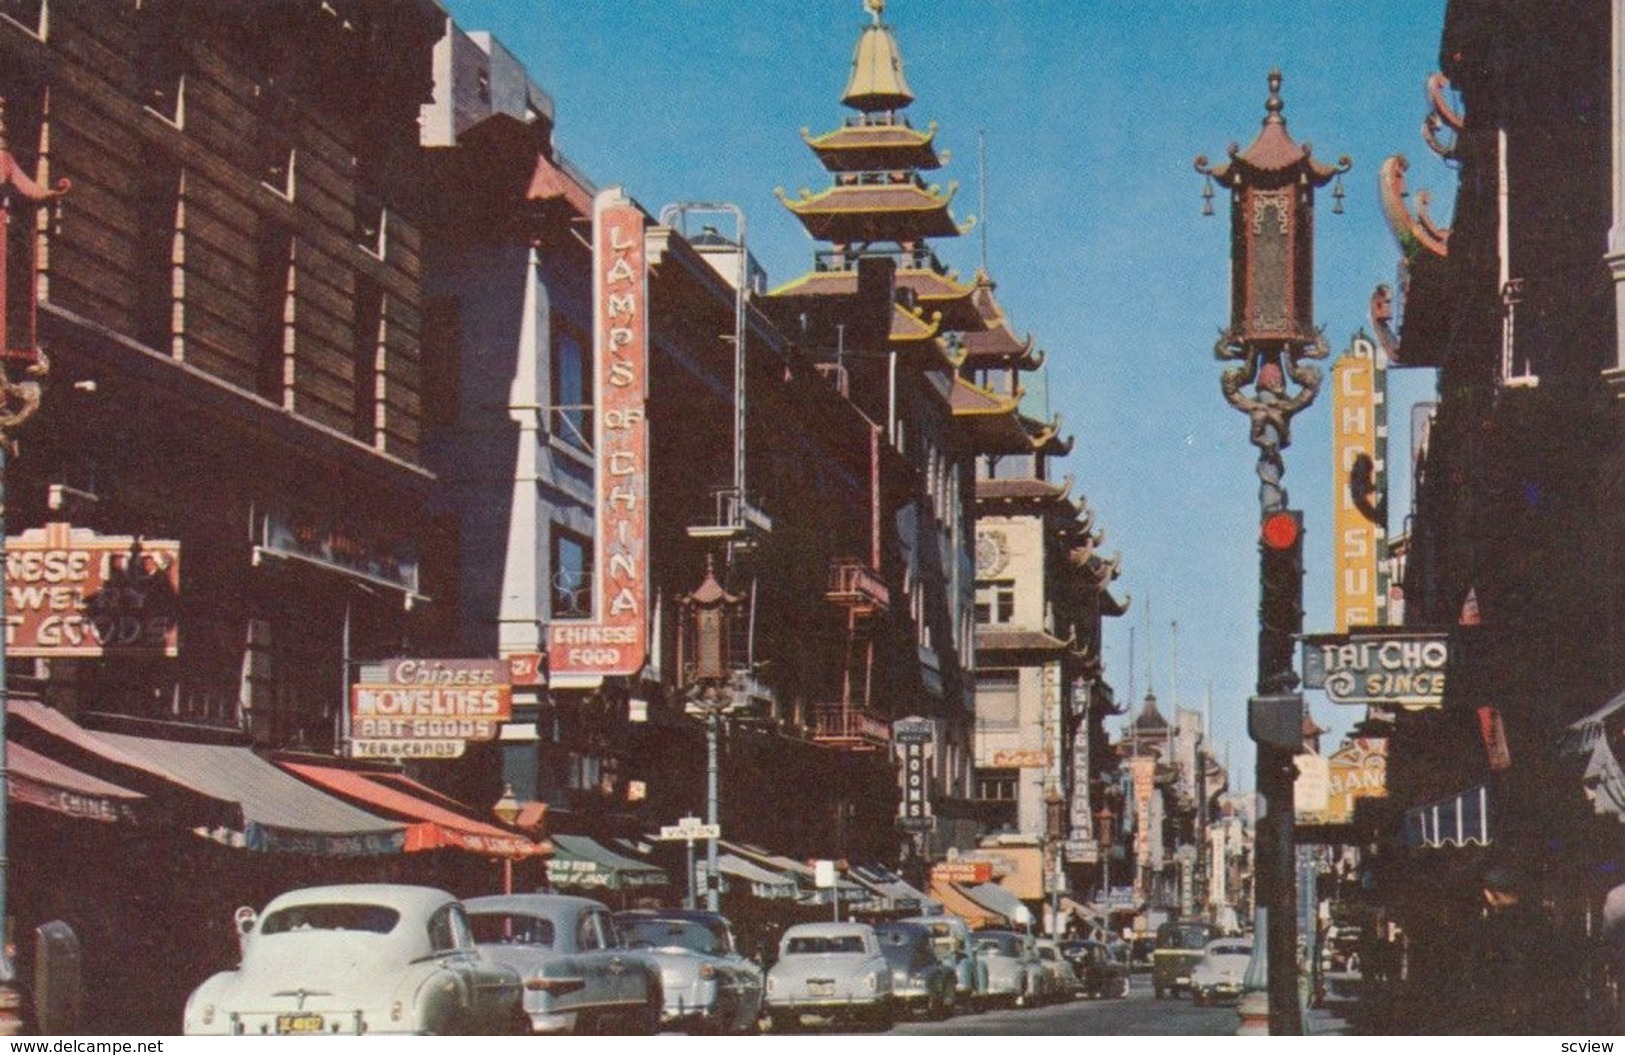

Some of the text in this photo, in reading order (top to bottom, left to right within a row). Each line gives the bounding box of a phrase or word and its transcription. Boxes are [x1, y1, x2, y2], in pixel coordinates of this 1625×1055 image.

[604, 226, 643, 616] LAMPS OF CHINA
[37, 615, 170, 647] GOODS
[553, 626, 638, 644] CHINESE
[568, 649, 621, 665] FOOD
[1321, 643, 1378, 672] TAI
[1378, 641, 1448, 670] CHO
[396, 659, 494, 685] Chinese
[1366, 673, 1446, 695] SINCE
[357, 689, 499, 715] NOVELTIES
[361, 719, 489, 737] ART GOODS
[909, 744, 921, 816] ROOMS
